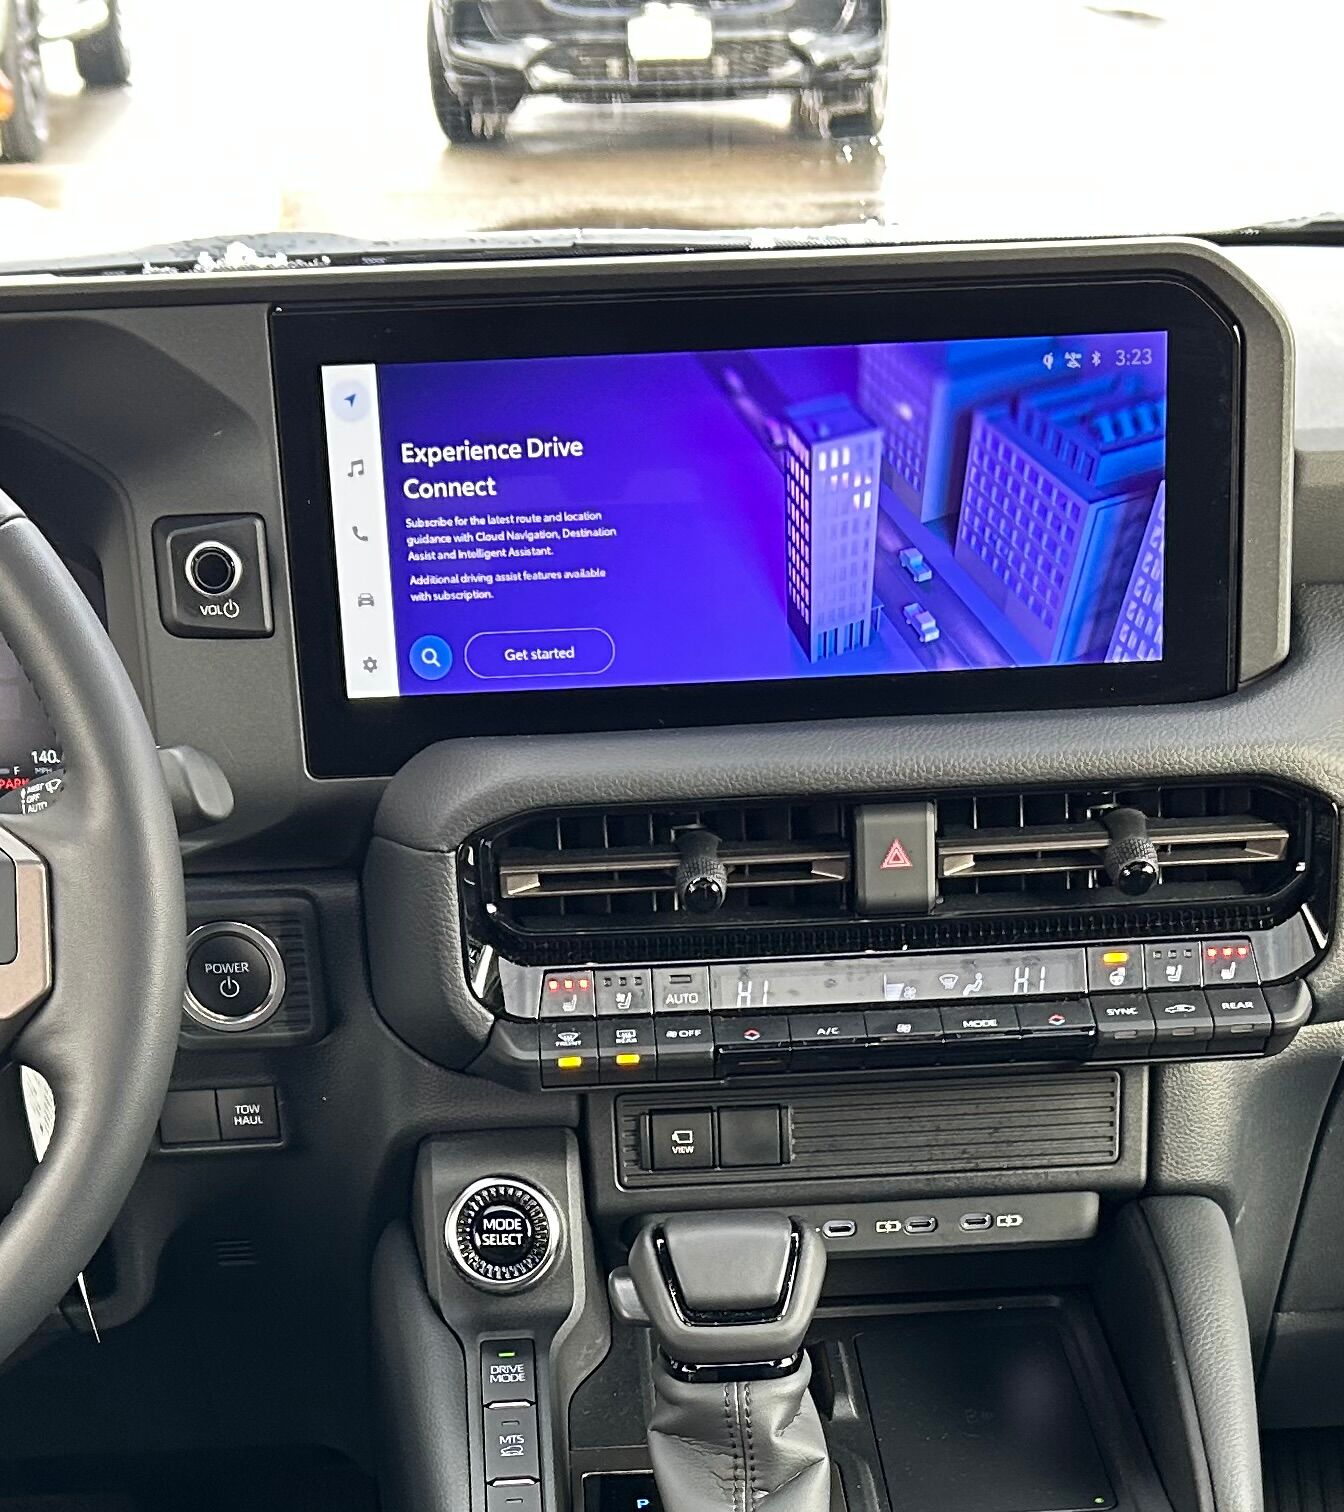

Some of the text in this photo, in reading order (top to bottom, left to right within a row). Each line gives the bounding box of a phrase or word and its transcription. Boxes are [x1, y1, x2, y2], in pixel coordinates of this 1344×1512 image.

[1116, 348, 1152, 366] 3:23
[400, 437, 583, 467] Experience Drive
[403, 477, 497, 499] Connect
[405, 511, 602, 528] Subscribe for the latest route and location
[406, 527, 617, 547] guidance with Cloud Navigation, Destination
[407, 546, 554, 562] Assist and Intelligent Assistant.
[409, 568, 606, 585] Additional driving assist features available
[410, 590, 494, 602] with subscription.
[200, 605, 223, 616] VOL
[504, 646, 575, 661] Get started
[13, 766, 20, 776] F
[204, 962, 249, 974] POWER
[665, 993, 699, 1005] AUTO
[1221, 1001, 1254, 1010] REAR
[1106, 1007, 1138, 1017] SYNC
[962, 1018, 998, 1028] MODE
[678, 1028, 702, 1038] OFF
[817, 1026, 839, 1036] A/C
[234, 1104, 260, 1115] TOW
[233, 1114, 264, 1126] HAUL
[671, 1145, 695, 1154] VIEW
[483, 1218, 522, 1231] MODE
[481, 1233, 523, 1246] SELECT
[490, 1363, 524, 1374] DRIVE
[489, 1374, 526, 1384] MODE
[499, 1434, 525, 1445] MTS
[636, 1498, 649, 1509] P
